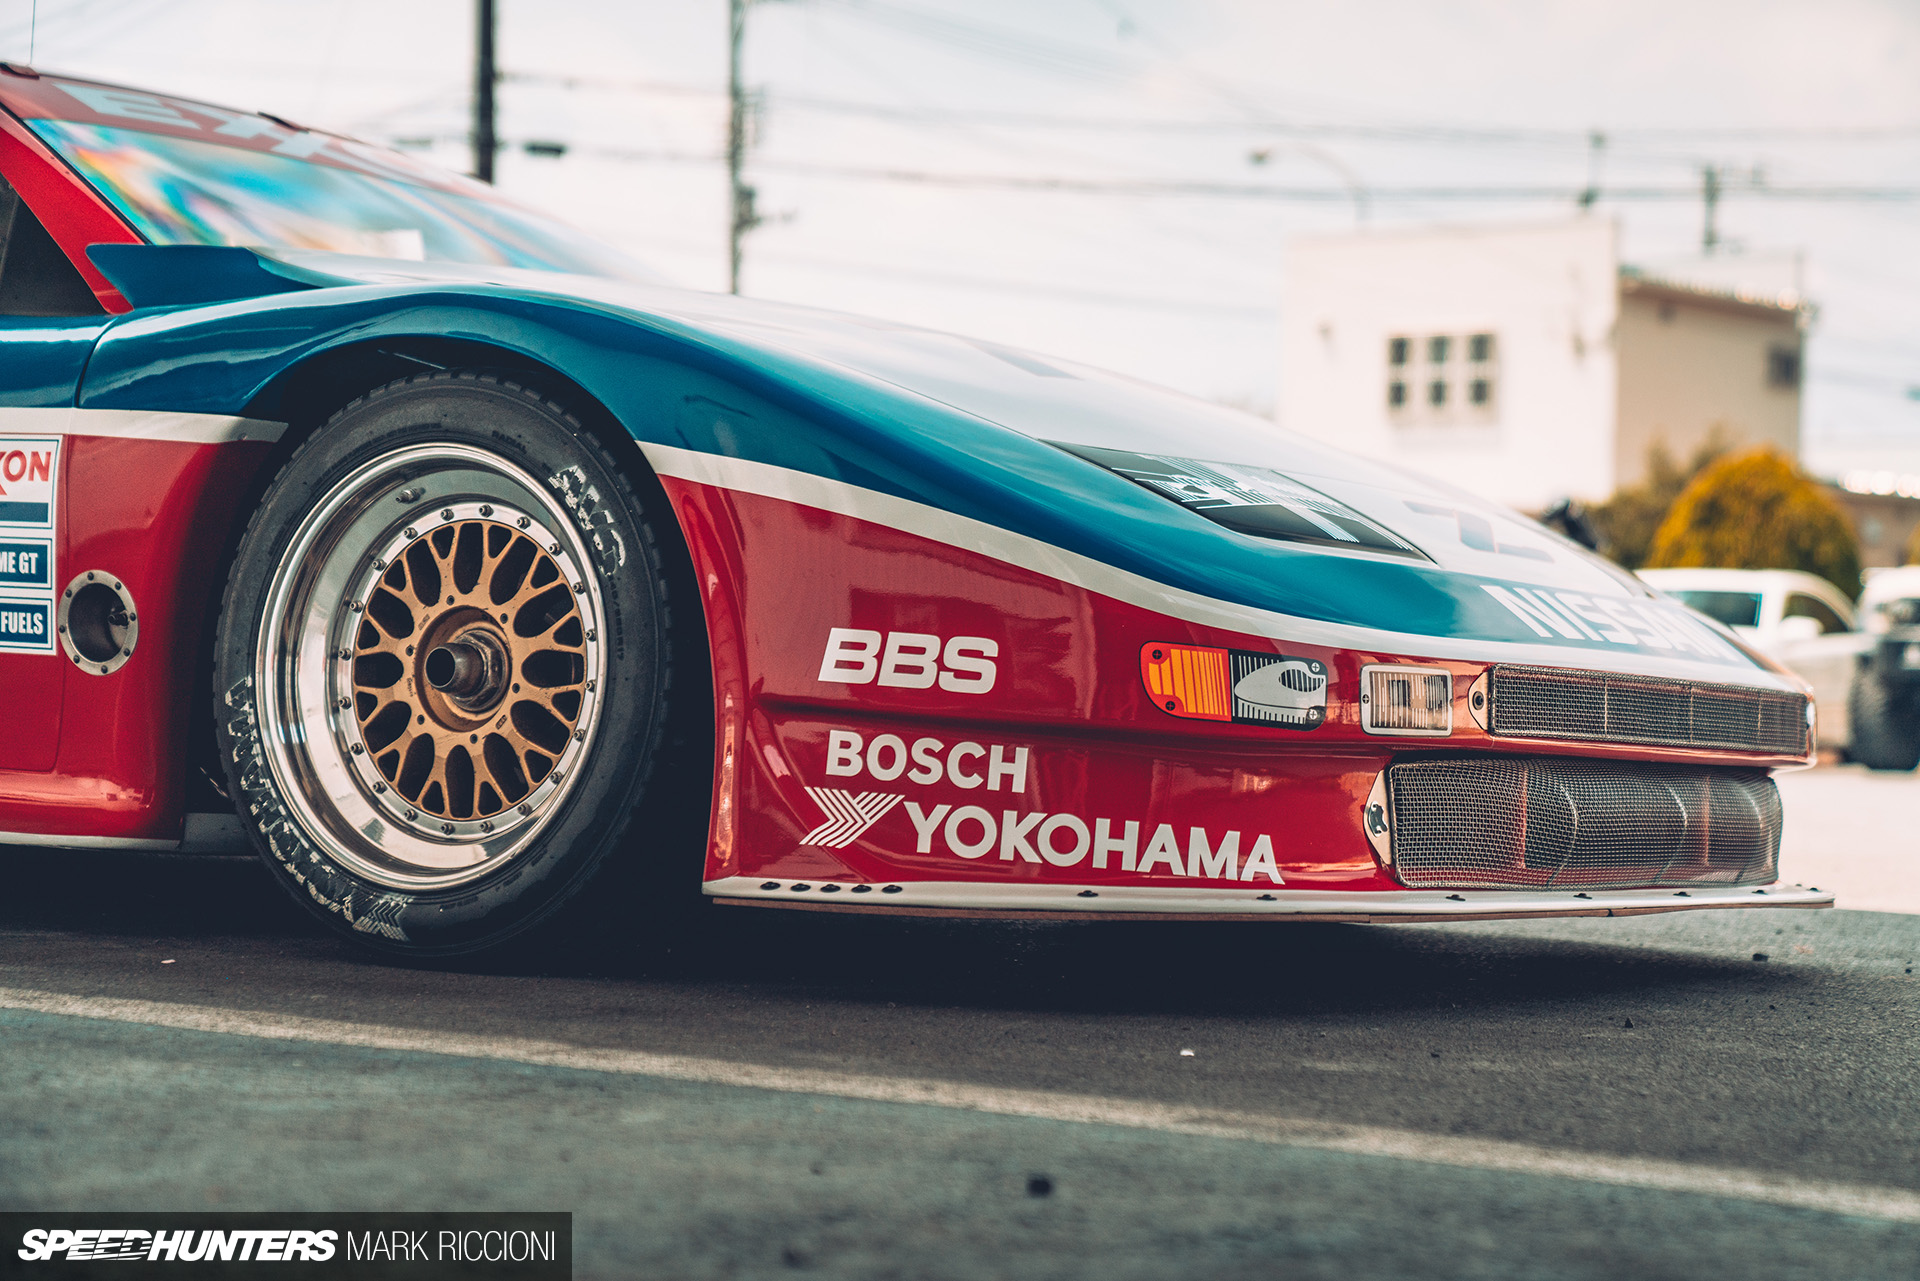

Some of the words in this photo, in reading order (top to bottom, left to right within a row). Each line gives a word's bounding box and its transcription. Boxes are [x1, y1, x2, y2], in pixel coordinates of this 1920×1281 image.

[19, 551, 38, 574] GT
[1, 611, 43, 635] FUELS
[818, 627, 999, 694] BBS
[826, 730, 1029, 794] BOSCH
[903, 801, 1286, 885] YOKOHAMA
